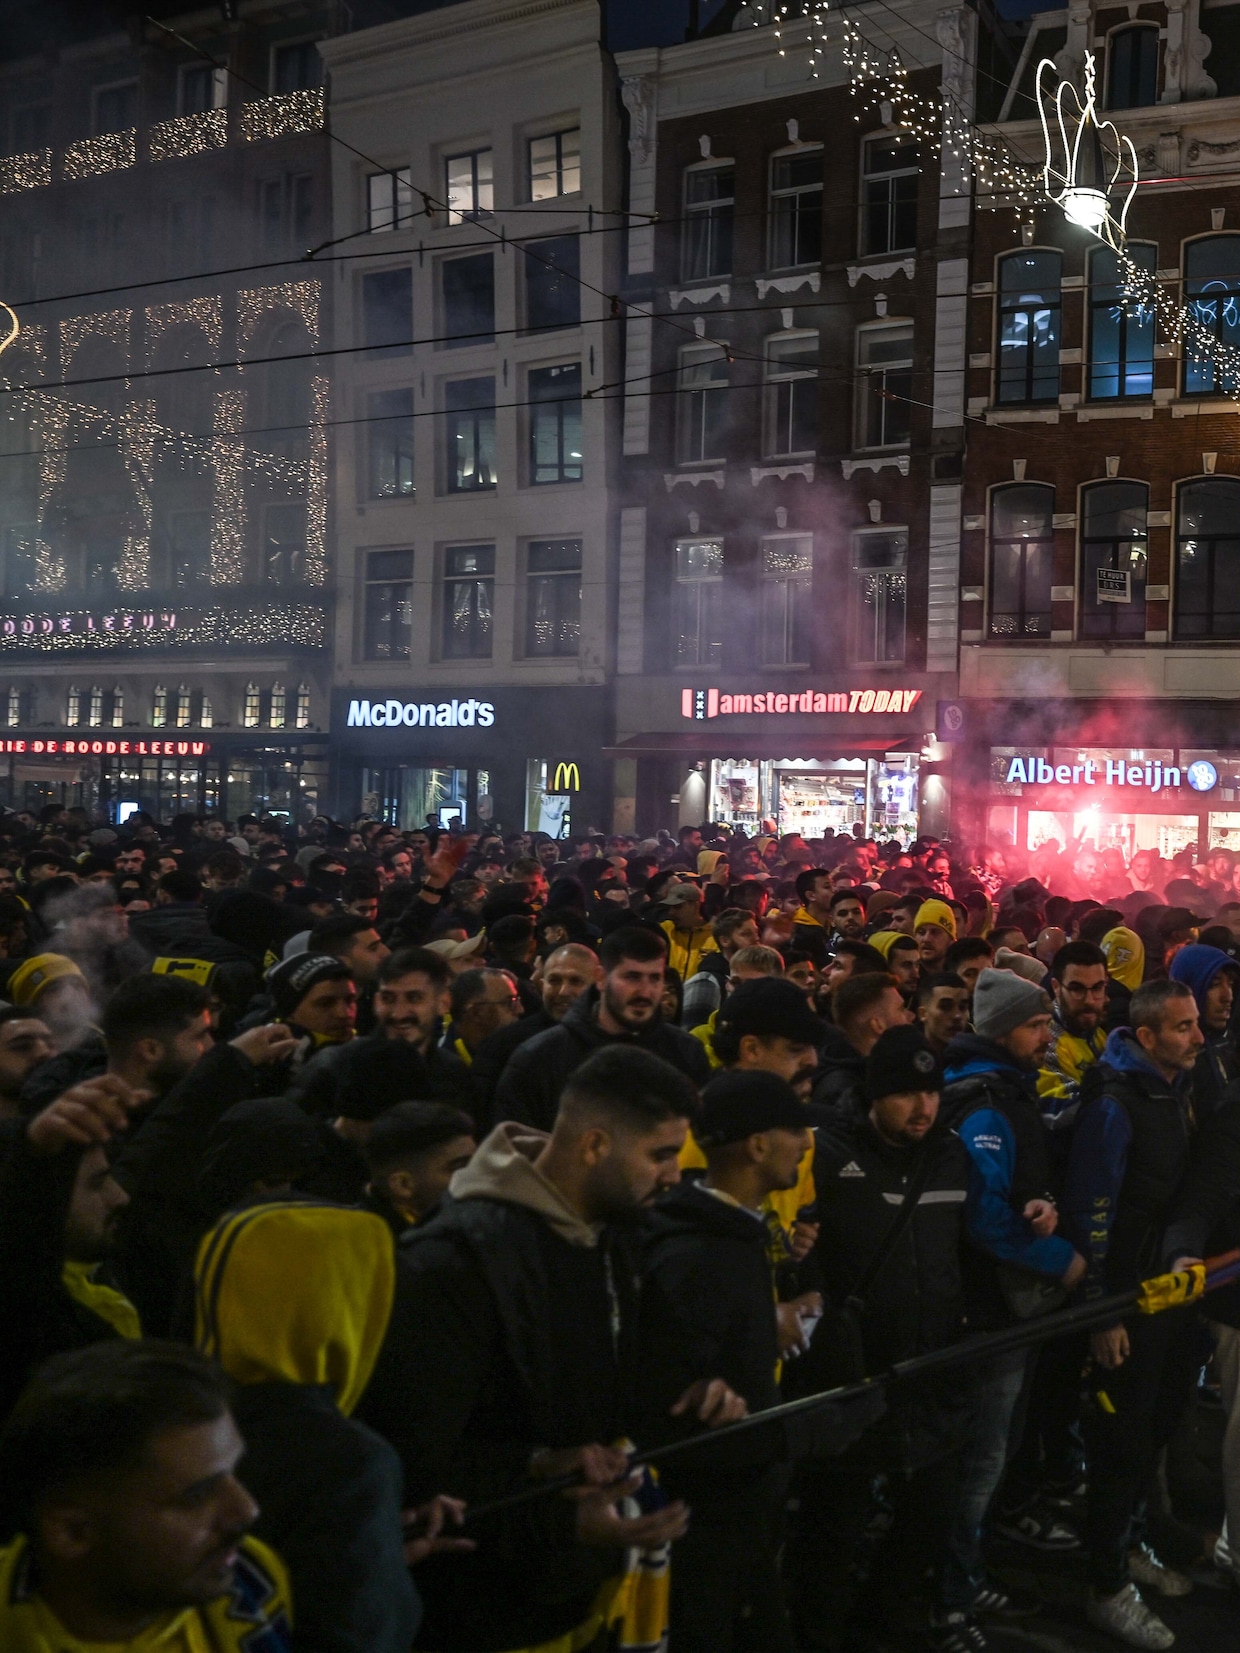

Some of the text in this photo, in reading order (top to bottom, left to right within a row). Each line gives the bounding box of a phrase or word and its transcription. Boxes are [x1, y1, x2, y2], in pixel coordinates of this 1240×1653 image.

[347, 699, 495, 728] McDonald's
[34, 741, 57, 753] DE
[65, 741, 130, 754] ROODE
[139, 742, 204, 755] LEEUW
[1007, 756, 1181, 793] Albert Heijn
